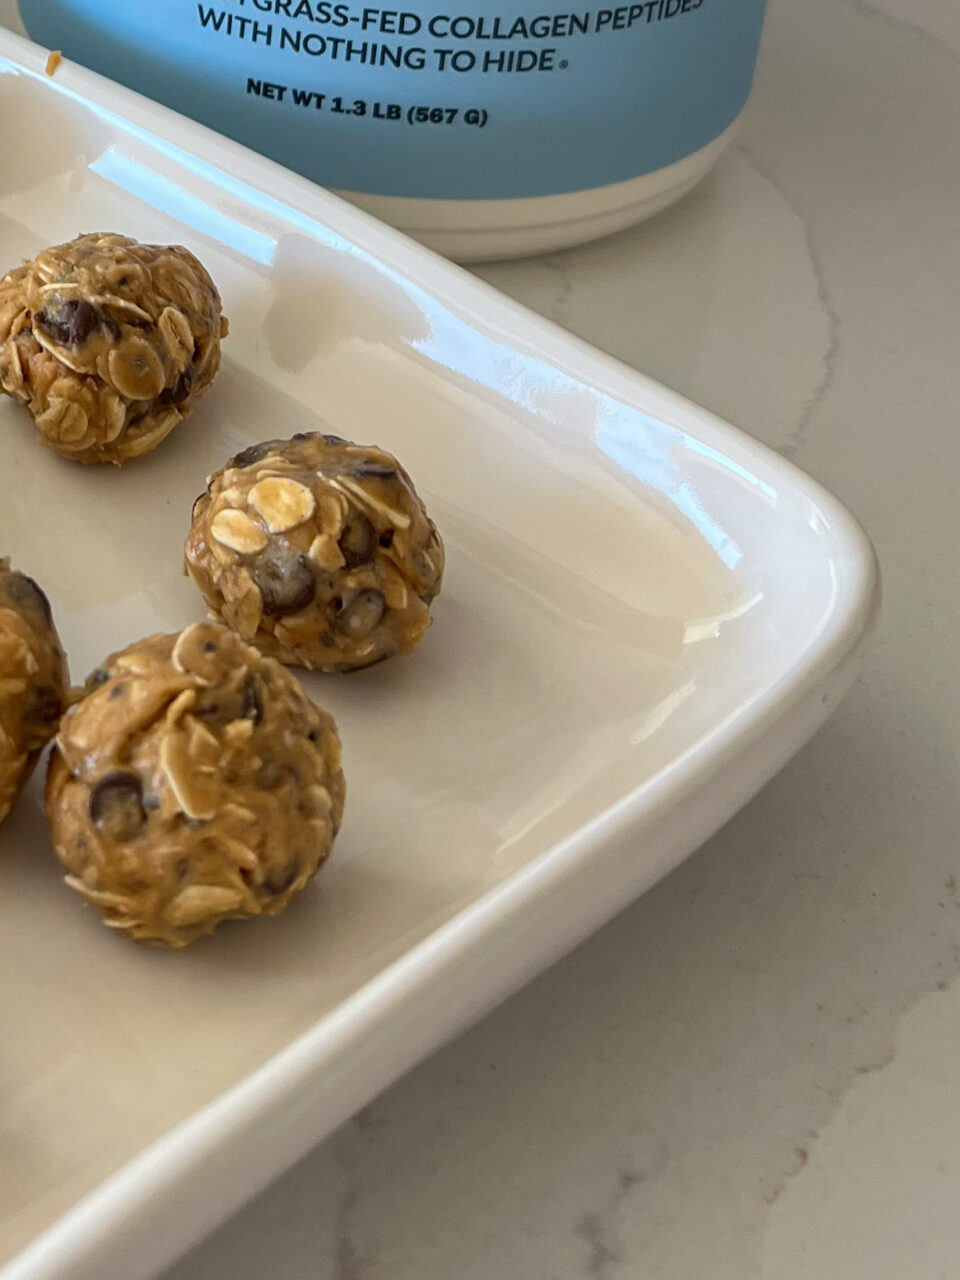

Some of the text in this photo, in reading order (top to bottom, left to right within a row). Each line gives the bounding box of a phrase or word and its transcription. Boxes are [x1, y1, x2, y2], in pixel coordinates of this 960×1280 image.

[197, 3, 273, 47] WITH
[279, 27, 427, 70] NOTHING
[433, 48, 476, 73] TO
[427, 12, 590, 40] COLLAGEN
[246, 77, 489, 128] NET WT 1.3 LB (567 G)
